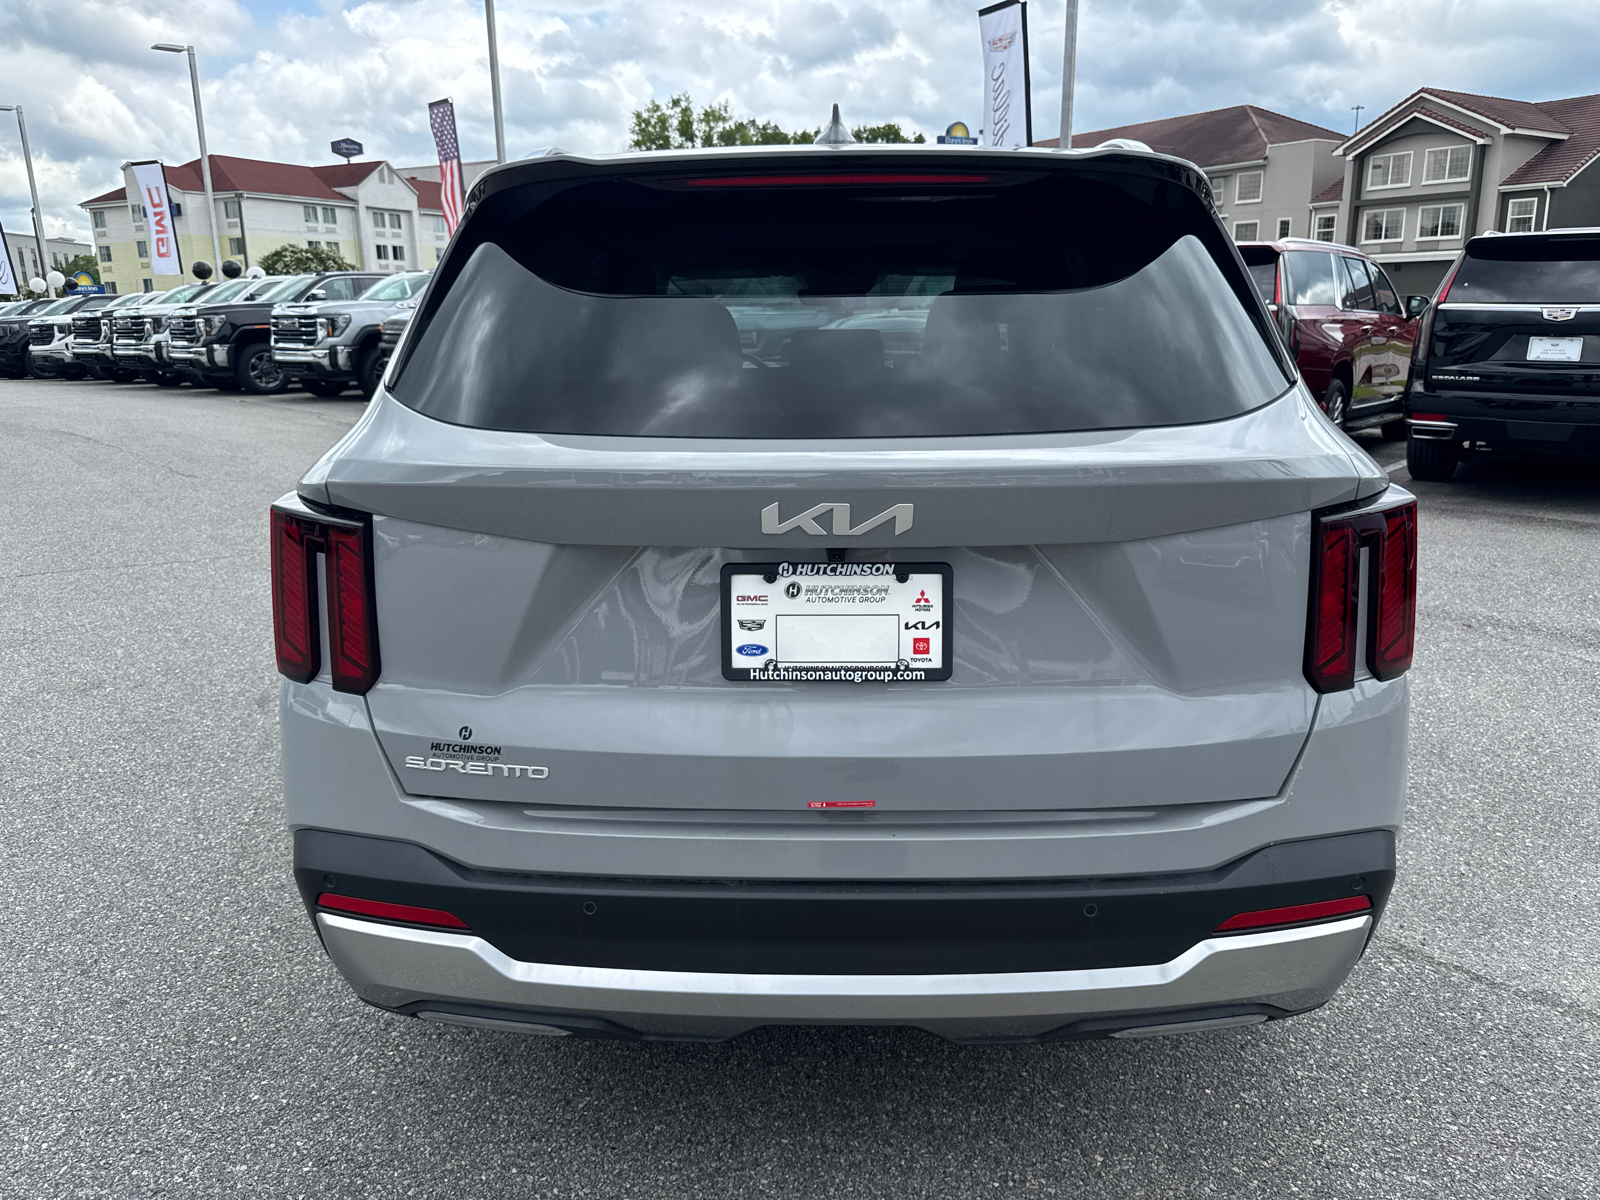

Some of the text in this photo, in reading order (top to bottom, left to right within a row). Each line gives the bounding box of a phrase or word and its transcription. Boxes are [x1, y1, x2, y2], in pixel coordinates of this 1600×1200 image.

[761, 502, 914, 536] KIA
[796, 564, 895, 576] HUTCHINSON
[804, 585, 889, 596] HUTCHINSON
[904, 621, 940, 630] KIA
[741, 645, 763, 655] Ford
[750, 668, 925, 682] Hutchinsonautogroup.com
[430, 742, 502, 755] HUTCHINSON
[432, 752, 474, 761] AUTOMOTIVE
[405, 755, 549, 779] SORENTO
